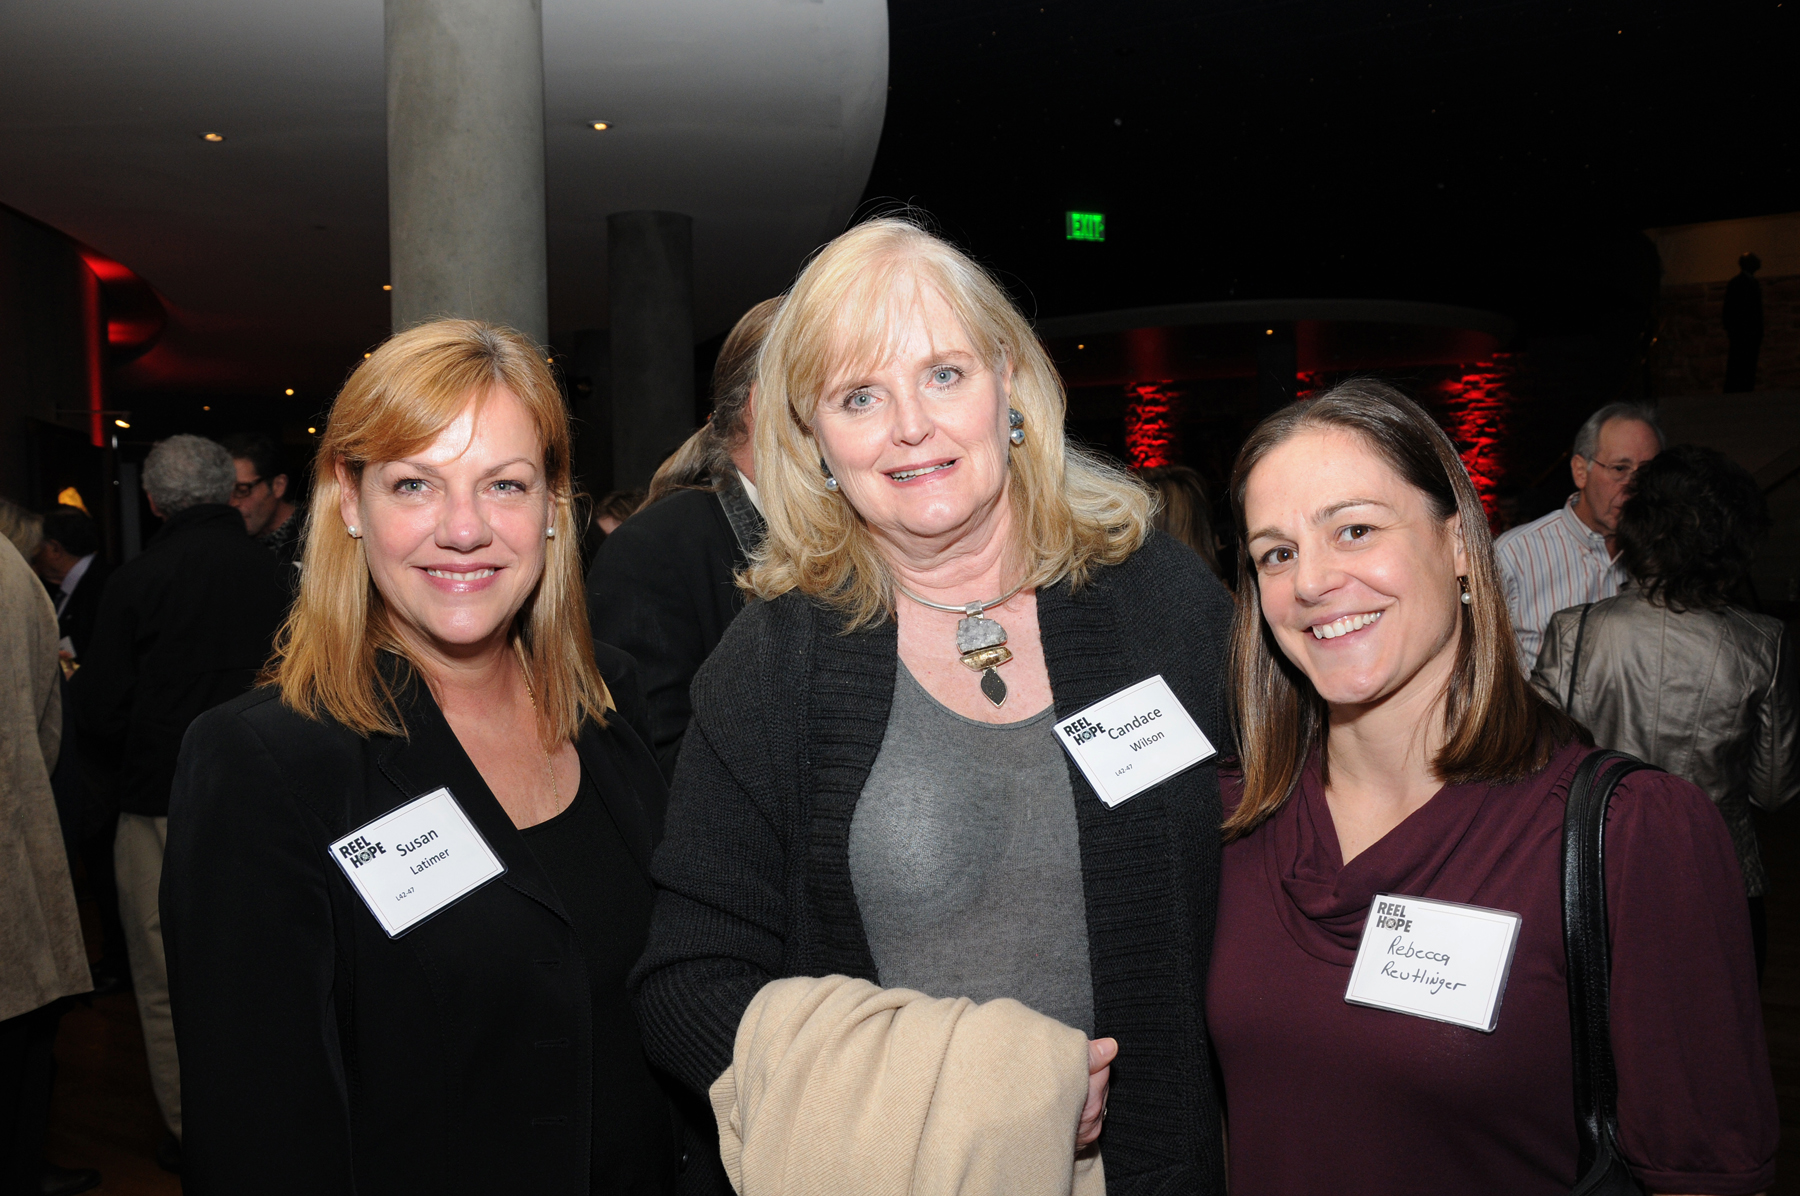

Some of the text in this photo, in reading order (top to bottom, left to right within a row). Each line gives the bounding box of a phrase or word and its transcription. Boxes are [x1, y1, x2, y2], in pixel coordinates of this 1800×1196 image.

[1071, 213, 1102, 237] EXIT
[1063, 716, 1092, 737] REEL
[1072, 722, 1107, 746] HOPE
[1107, 708, 1163, 740] Candace
[1129, 730, 1165, 752] Wilson
[1114, 763, 1134, 777] L42-47
[338, 835, 371, 859] REEL
[395, 828, 439, 857] Susan
[350, 841, 387, 869] HOPE
[409, 847, 450, 875] Latimer
[395, 886, 416, 902] L42-47
[1377, 901, 1406, 918] REEL
[1376, 916, 1413, 933] HOPE
[1386, 935, 1451, 966] Rebecca
[1380, 960, 1467, 995] Reutlinger
